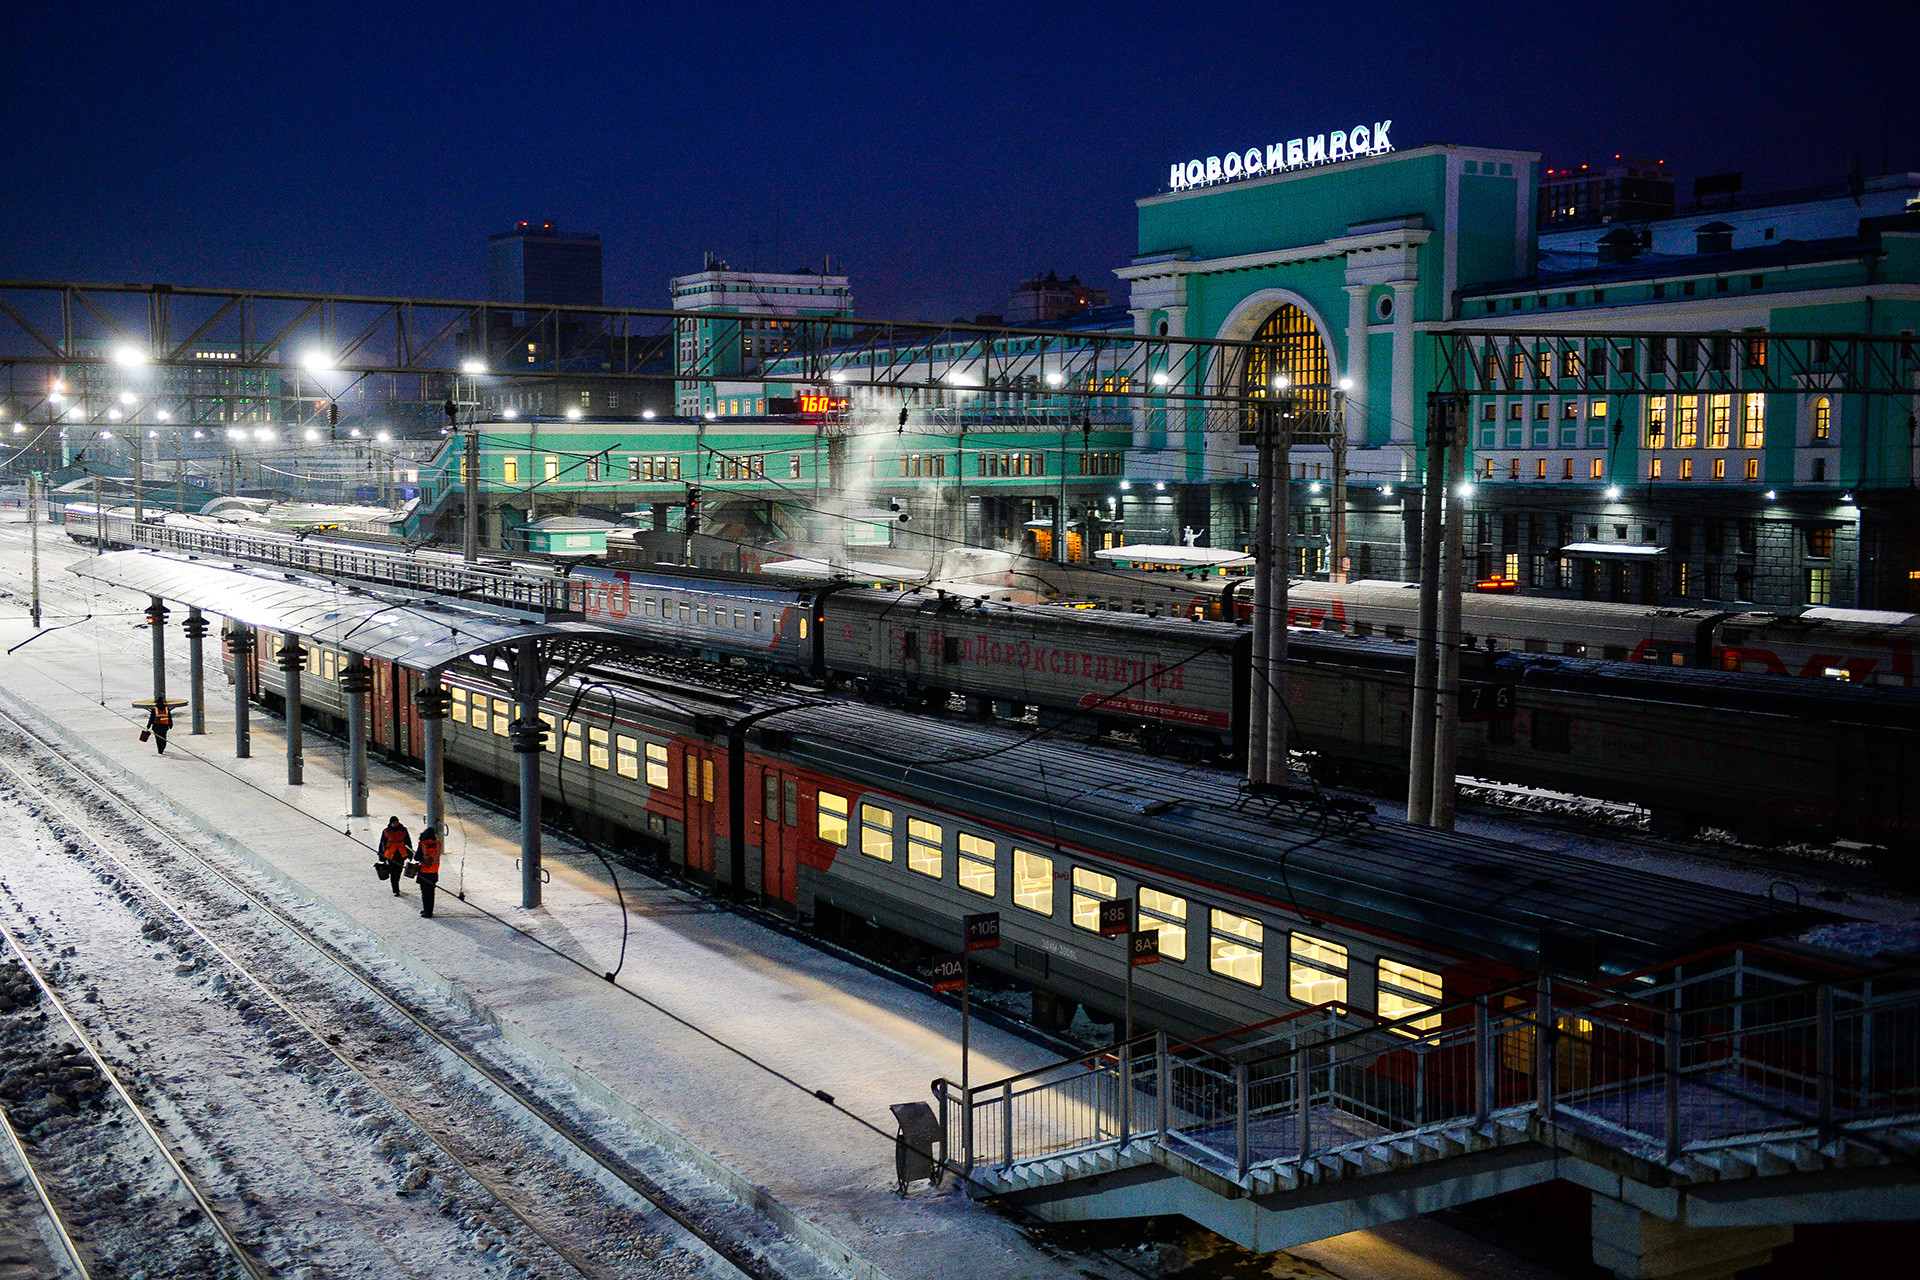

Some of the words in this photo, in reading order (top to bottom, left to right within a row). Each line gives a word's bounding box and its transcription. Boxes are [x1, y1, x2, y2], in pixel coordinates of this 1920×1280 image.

[1170, 120, 1393, 188] НОВОСИБИРСК
[1471, 688, 1482, 709] 7
[1497, 687, 1507, 708] 6
[1109, 907, 1126, 922] 8Б
[977, 920, 998, 935] 10Б
[1135, 938, 1152, 952] 8А
[941, 961, 963, 976] 10А
